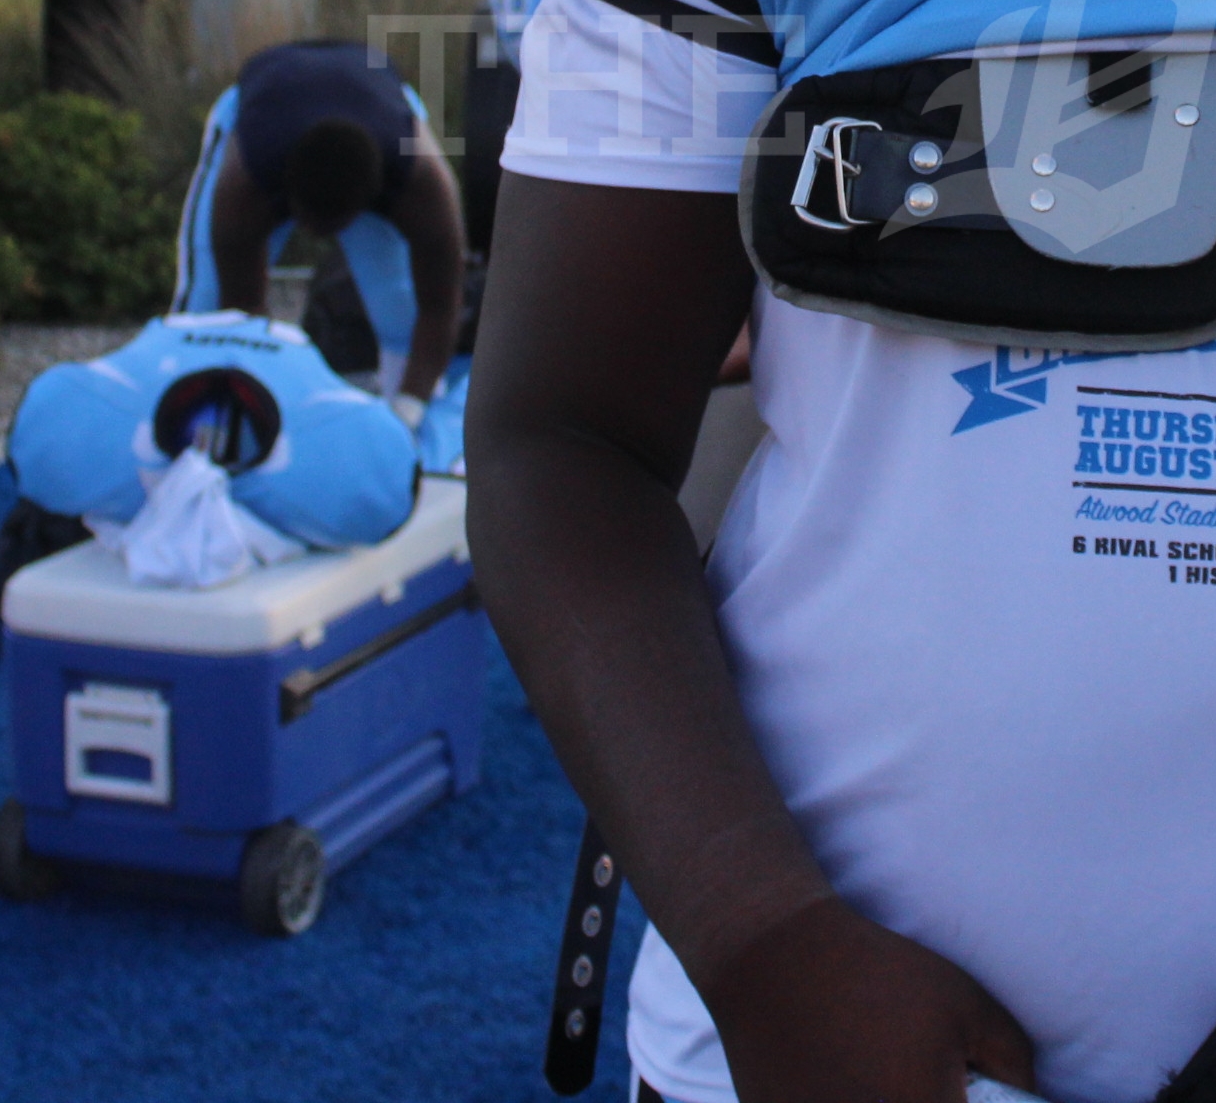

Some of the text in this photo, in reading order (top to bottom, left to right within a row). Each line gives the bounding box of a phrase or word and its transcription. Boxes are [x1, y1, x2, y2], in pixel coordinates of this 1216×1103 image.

[1075, 495, 1159, 524] Atwood
[1072, 535, 1087, 554] 6
[1094, 537, 1160, 559] RIVAL
[1168, 565, 1178, 583] 1
